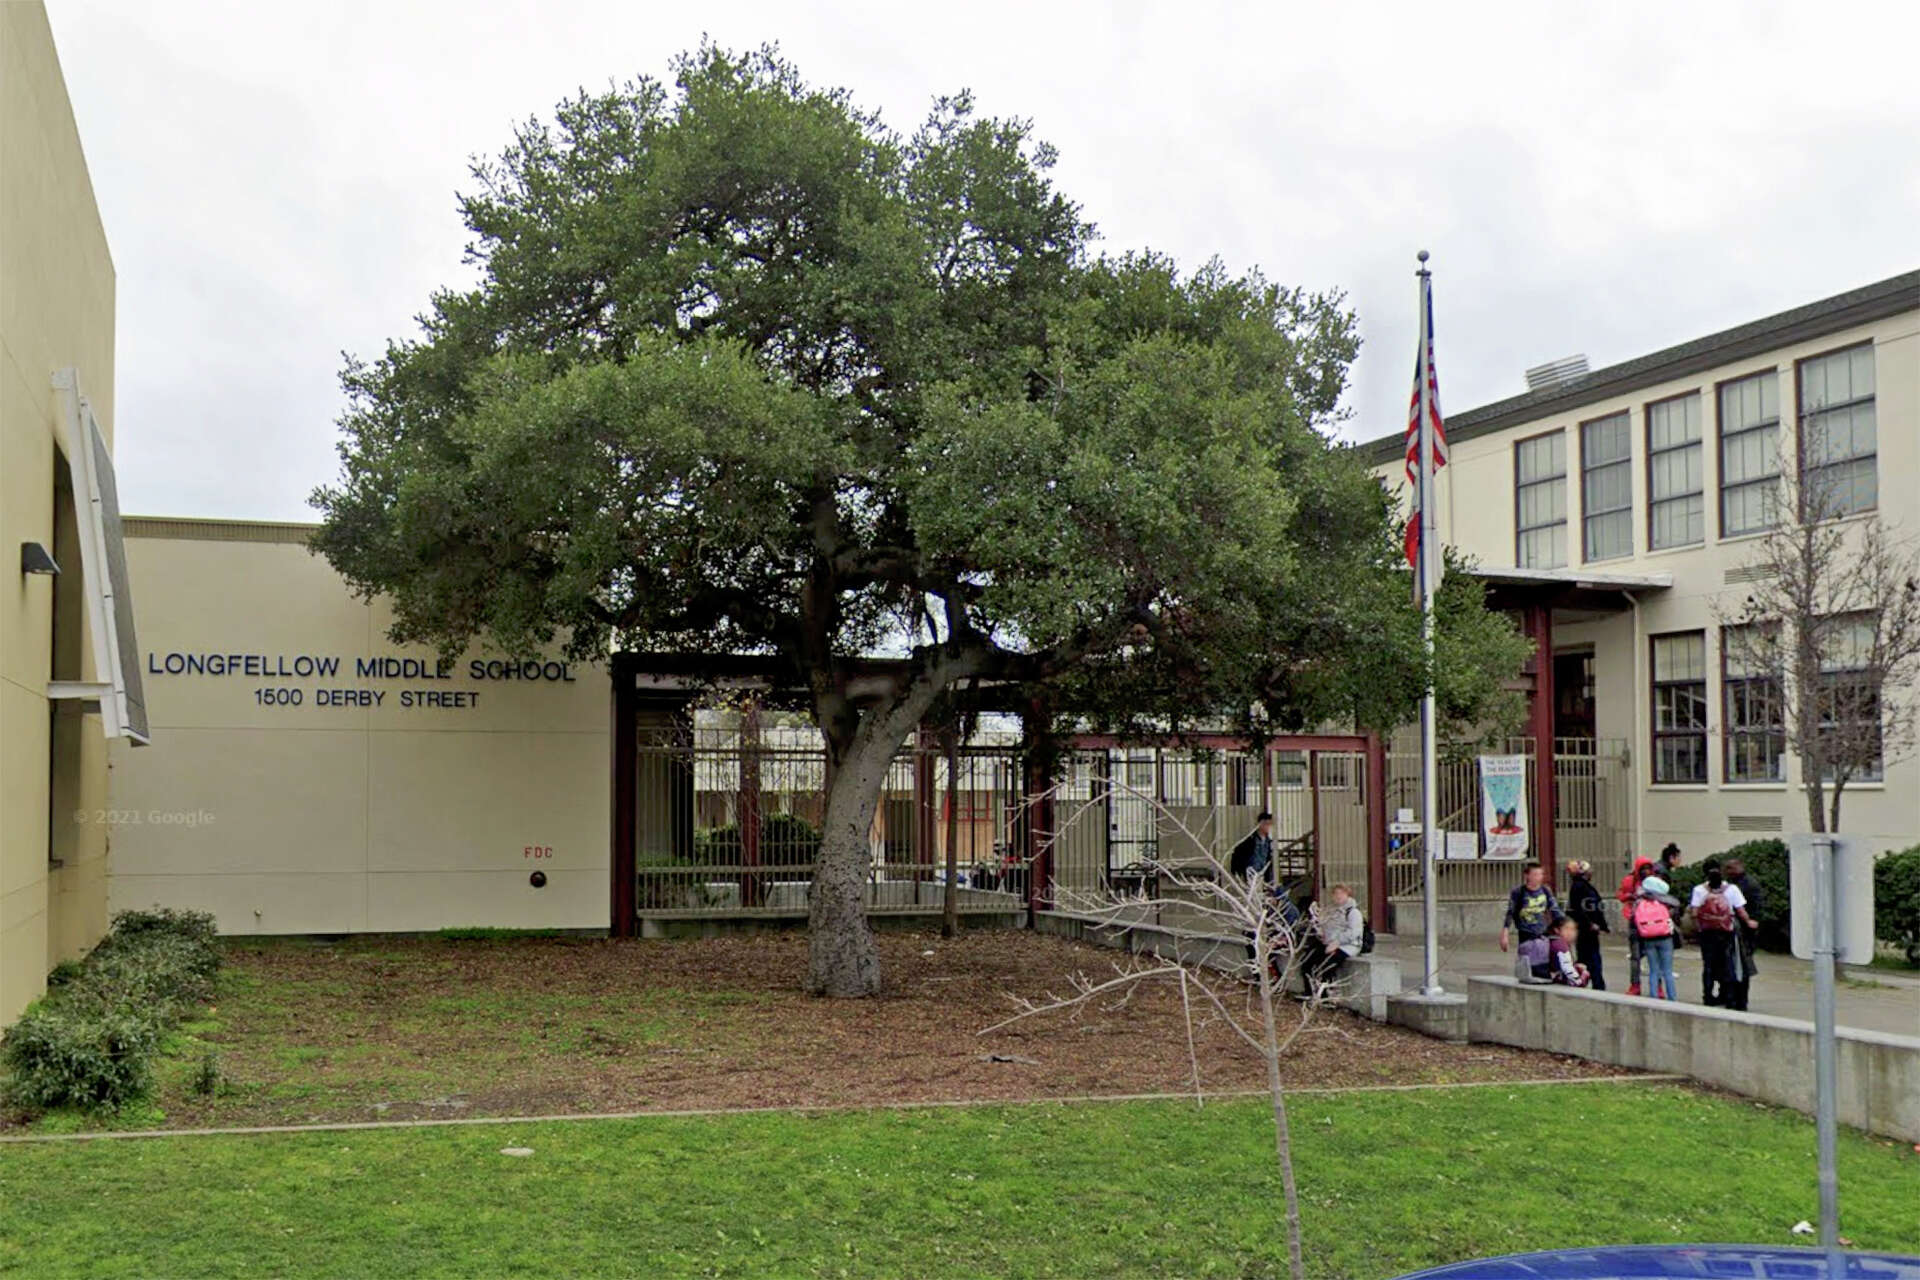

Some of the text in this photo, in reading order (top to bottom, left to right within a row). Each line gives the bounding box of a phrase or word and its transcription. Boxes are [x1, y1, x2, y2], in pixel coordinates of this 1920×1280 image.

[149, 653, 340, 677] LONGFELLOW
[470, 660, 577, 682] SCHOOL
[254, 688, 480, 708] 1500 DERBY STREET
[524, 847, 553, 858] FDC
